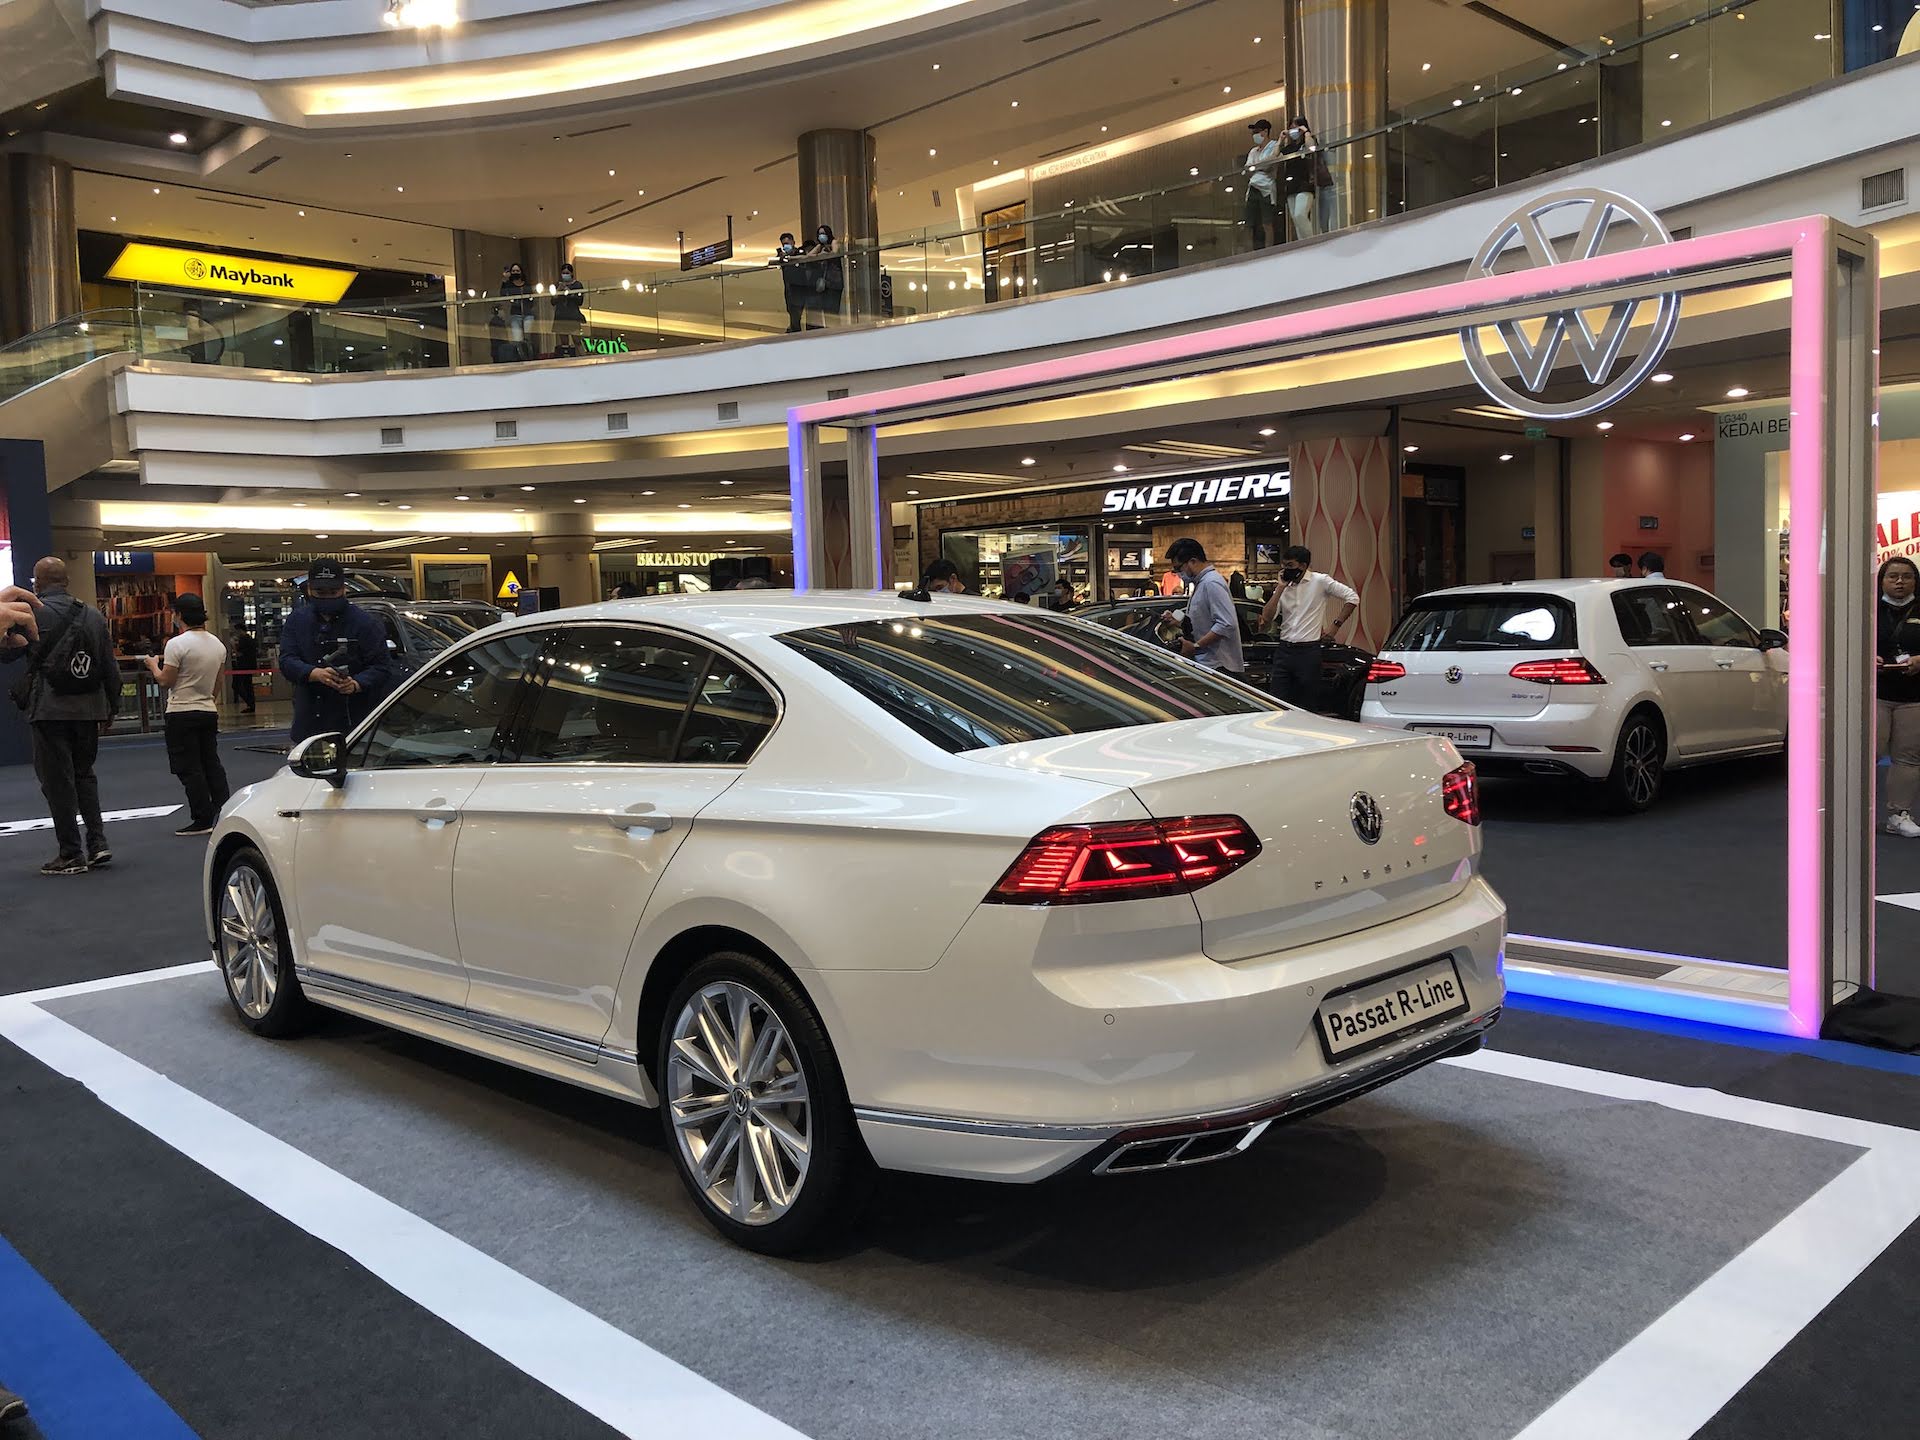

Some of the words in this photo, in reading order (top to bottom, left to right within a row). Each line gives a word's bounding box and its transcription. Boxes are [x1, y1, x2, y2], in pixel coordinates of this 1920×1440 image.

[209, 264, 295, 288] Maybank
[1718, 413, 1747, 424] LG340
[1719, 420, 1763, 438] KEDAI
[1768, 418, 1791, 433] BE
[1101, 471, 1291, 513] SKECHERS
[1447, 732, 1478, 742] R-Line
[1314, 854, 1428, 890] PASSAT
[1328, 998, 1397, 1042] Passat
[1396, 978, 1456, 1017] R-Line
